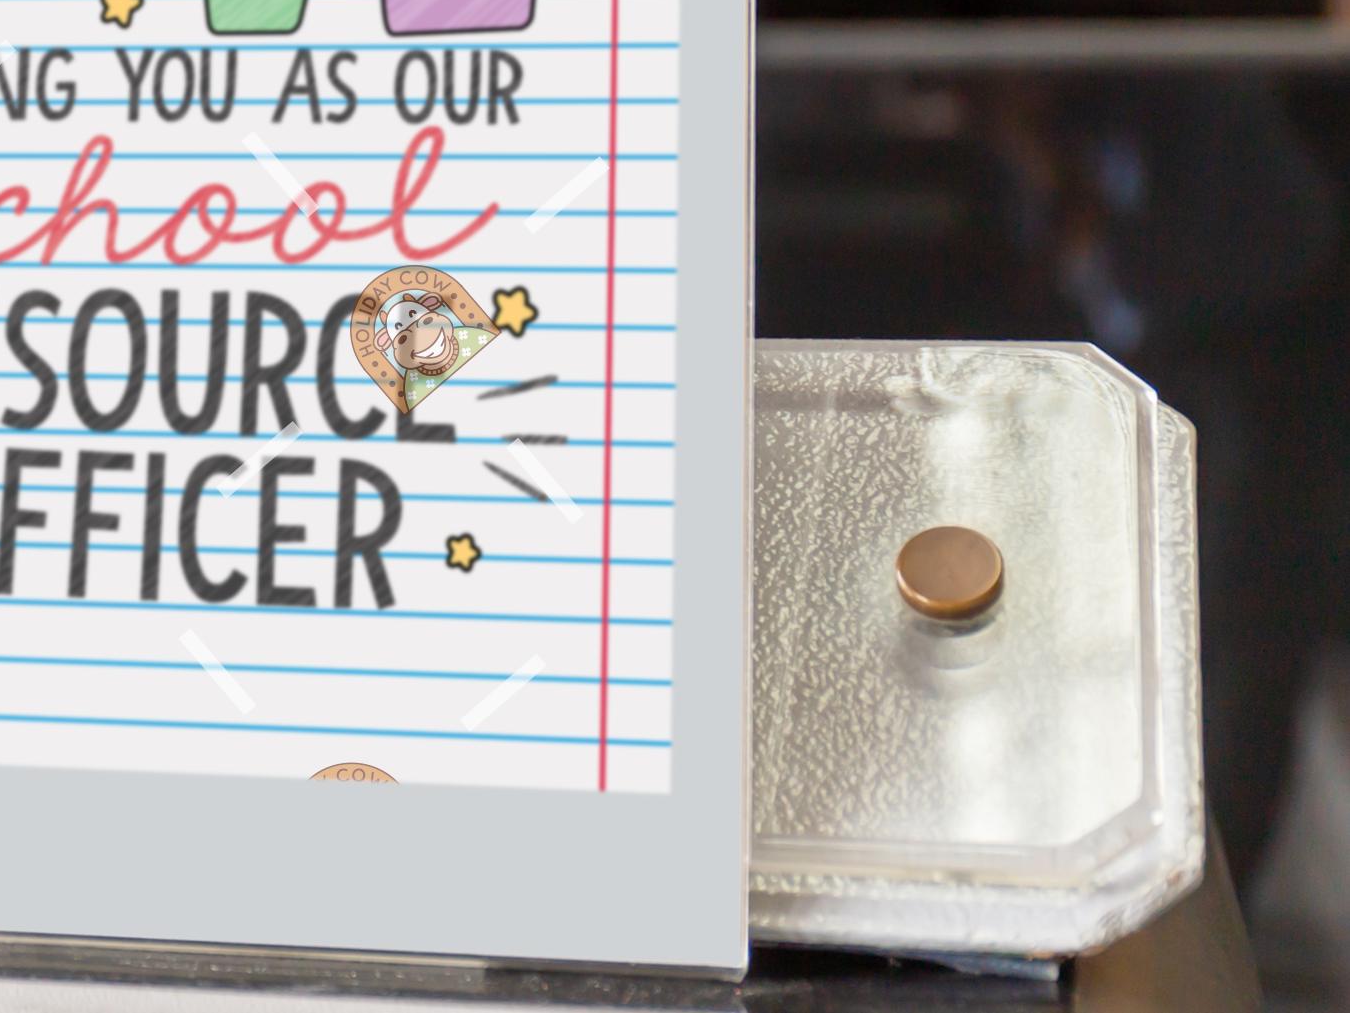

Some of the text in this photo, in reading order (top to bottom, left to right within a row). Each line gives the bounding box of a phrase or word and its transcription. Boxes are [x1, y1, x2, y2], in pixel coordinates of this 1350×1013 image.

[115, 47, 238, 123] YOU
[271, 48, 358, 124] AS
[394, 49, 523, 126] OUR
